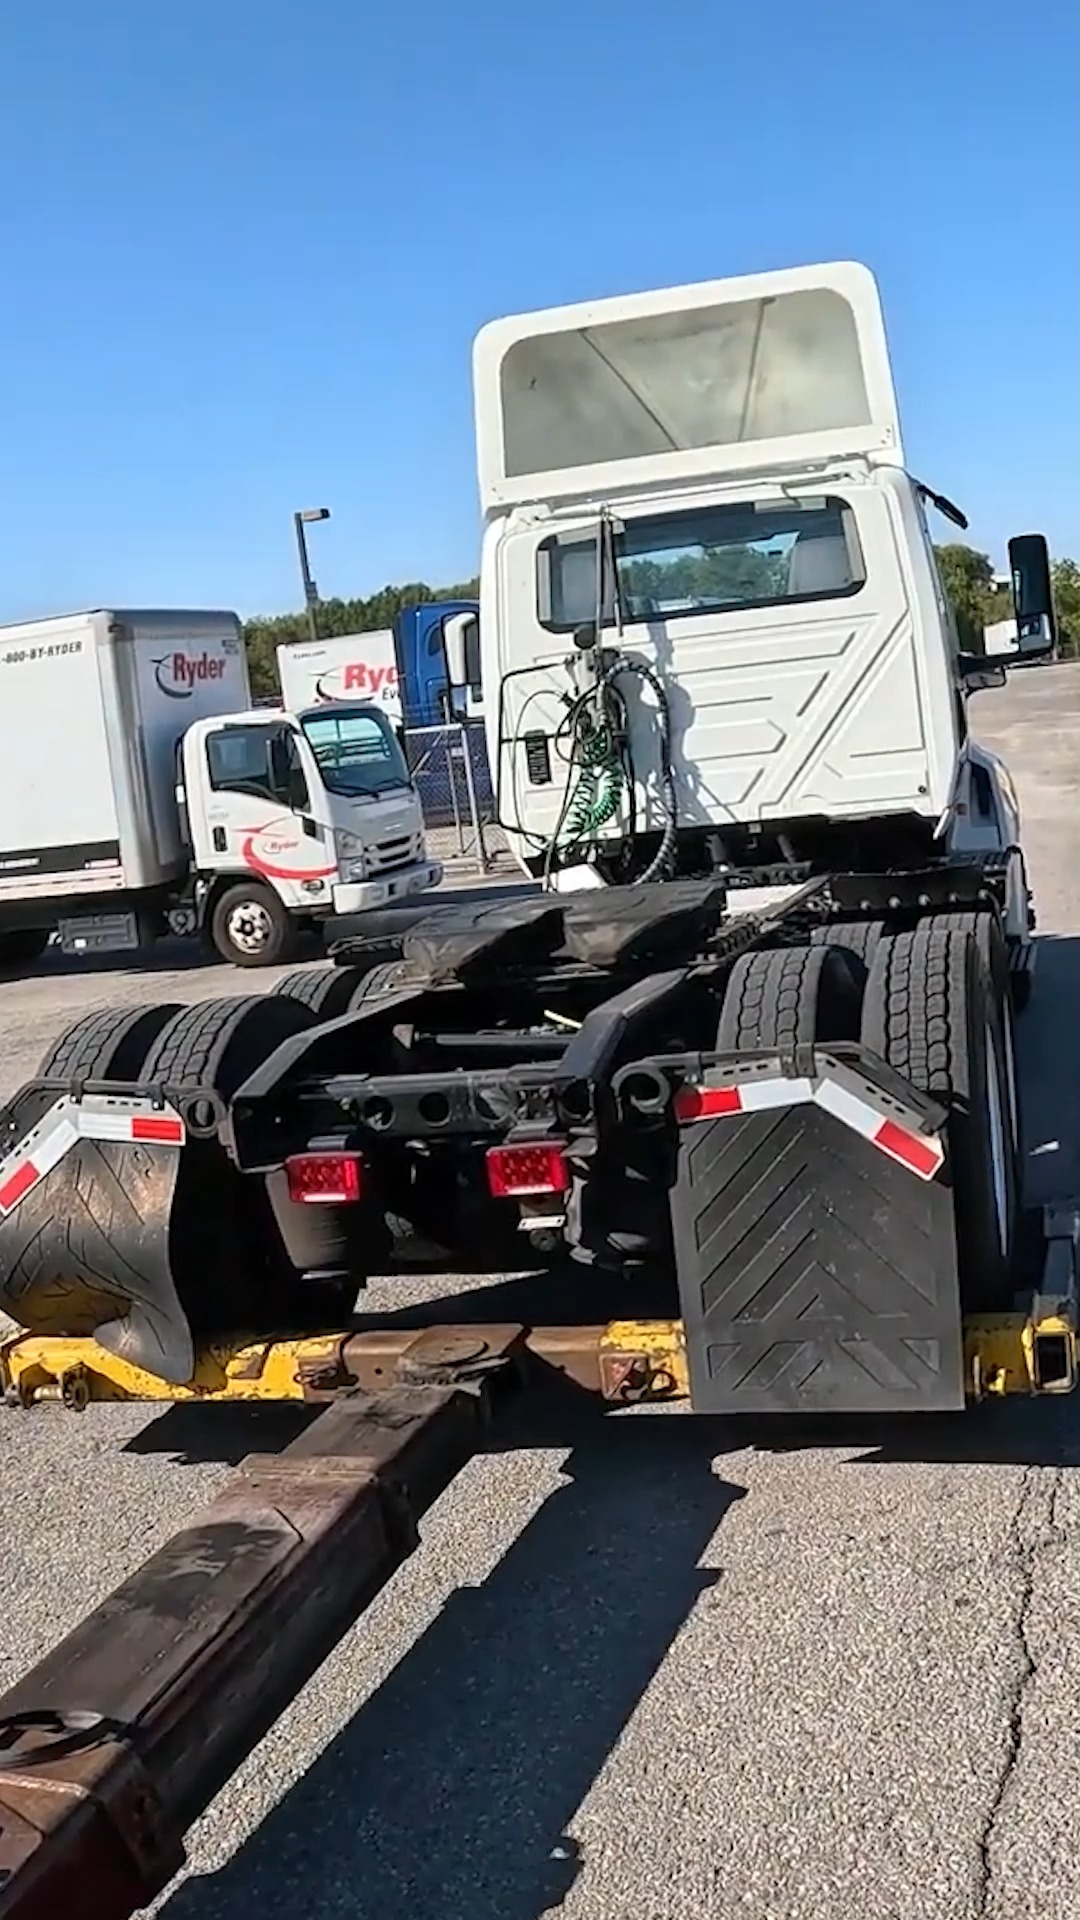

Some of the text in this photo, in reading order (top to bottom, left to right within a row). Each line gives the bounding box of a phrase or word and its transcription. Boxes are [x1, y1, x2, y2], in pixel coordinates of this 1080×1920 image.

[173, 651, 226, 688] Ryder
[382, 687, 399, 701] Ev
[270, 841, 299, 852] Ryder
